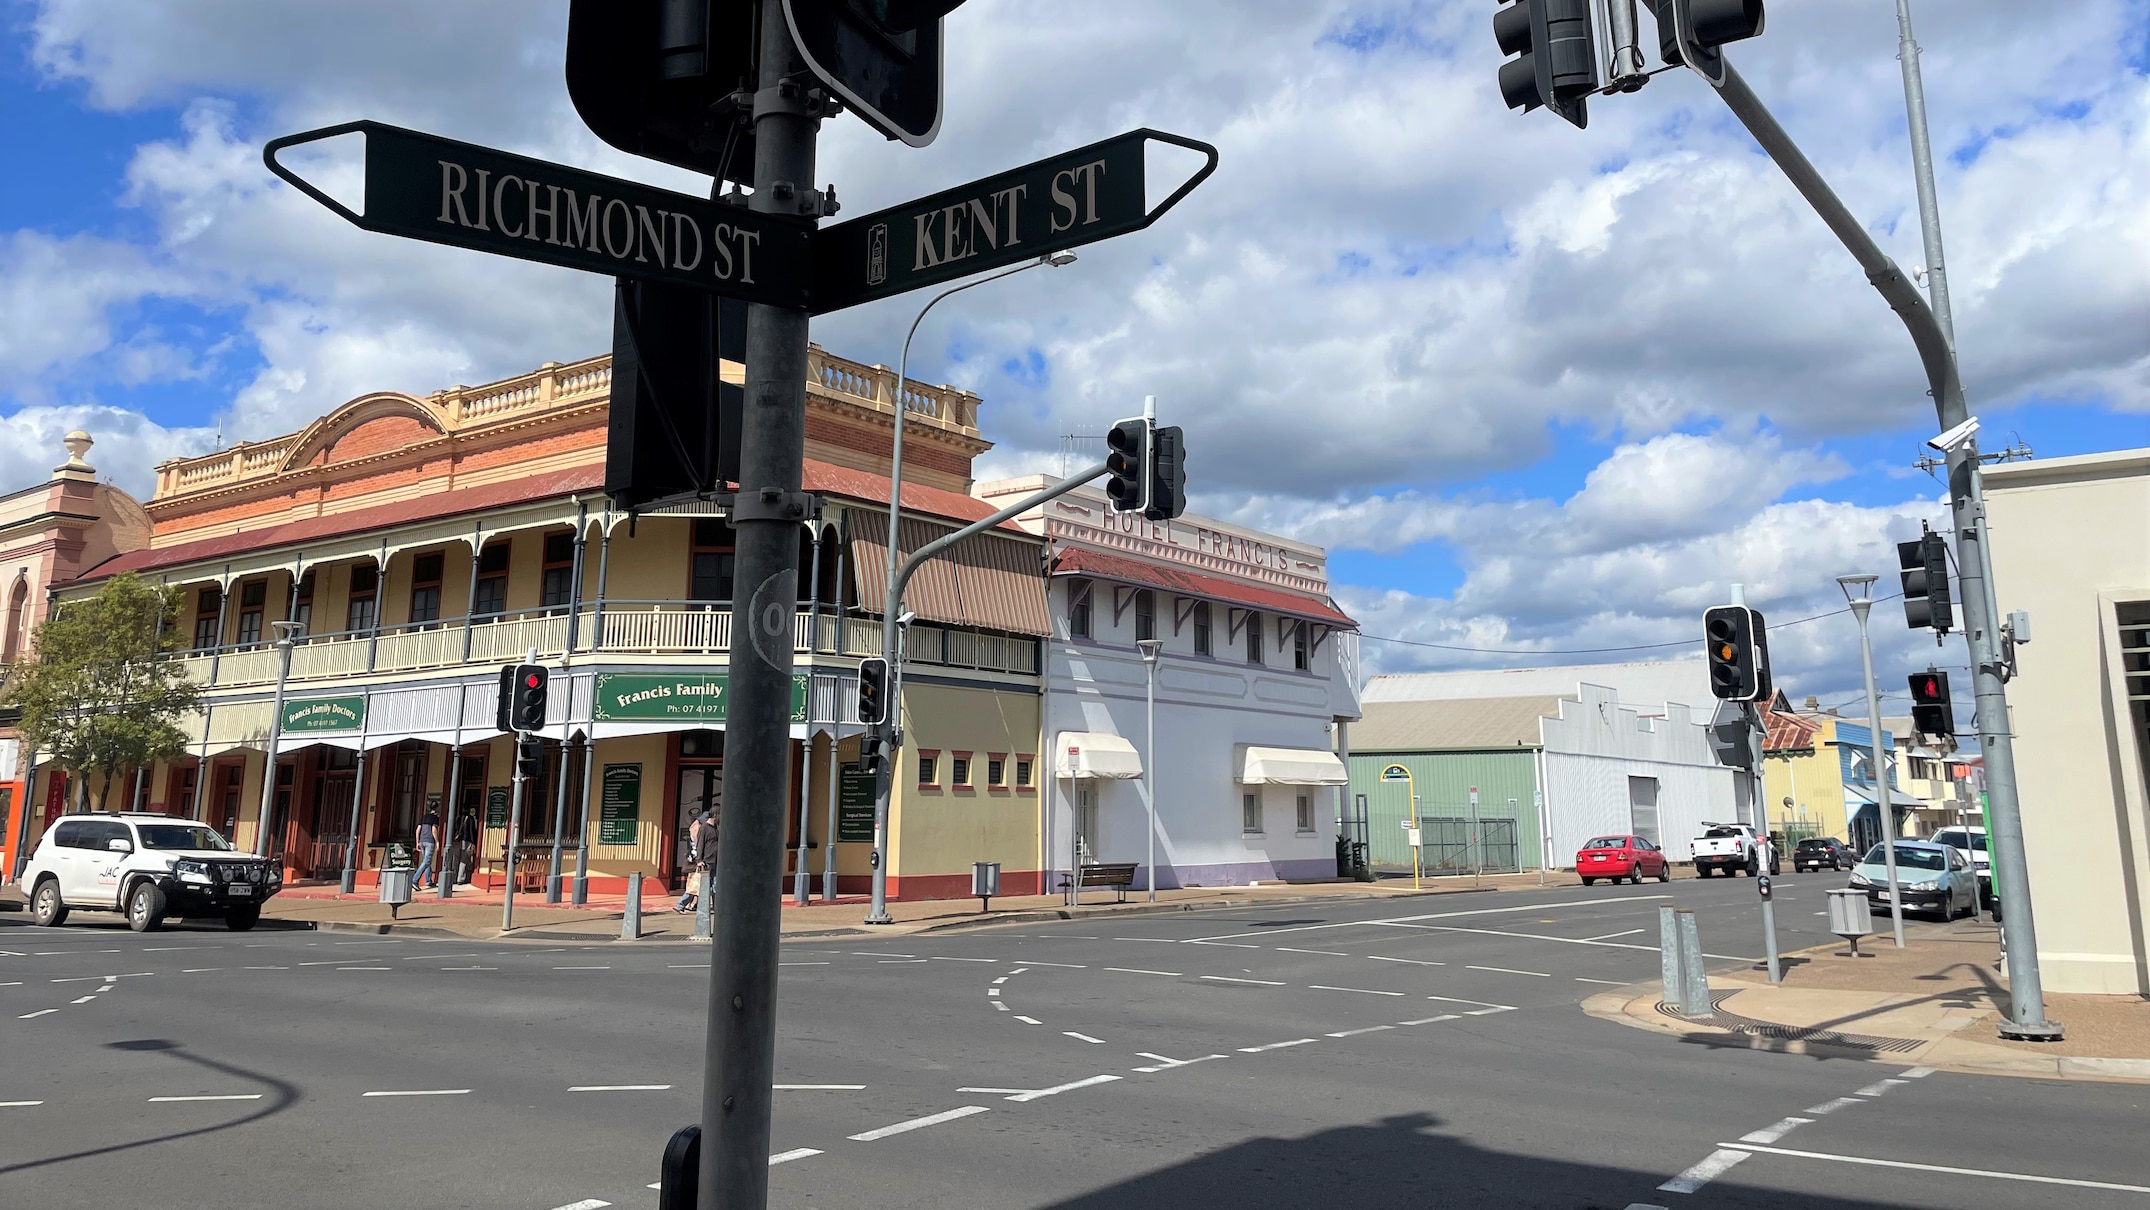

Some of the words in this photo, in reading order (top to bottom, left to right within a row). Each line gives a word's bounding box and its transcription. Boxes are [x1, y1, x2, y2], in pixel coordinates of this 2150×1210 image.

[436, 160, 703, 271] RICHMOND
[714, 223, 760, 284] ST
[912, 184, 1027, 272] KENT
[1050, 159, 1106, 233] ST
[1101, 503, 1178, 545] HOTEL
[1198, 527, 1288, 570] FRANCIS
[288, 706, 311, 724] Francis
[312, 703, 331, 716] Family
[332, 703, 356, 721] Doctors
[617, 685, 672, 708] Francis
[676, 682, 723, 699] Family
[667, 704, 680, 713] Ph:
[682, 704, 694, 713] 07
[695, 704, 718, 713] 4197
